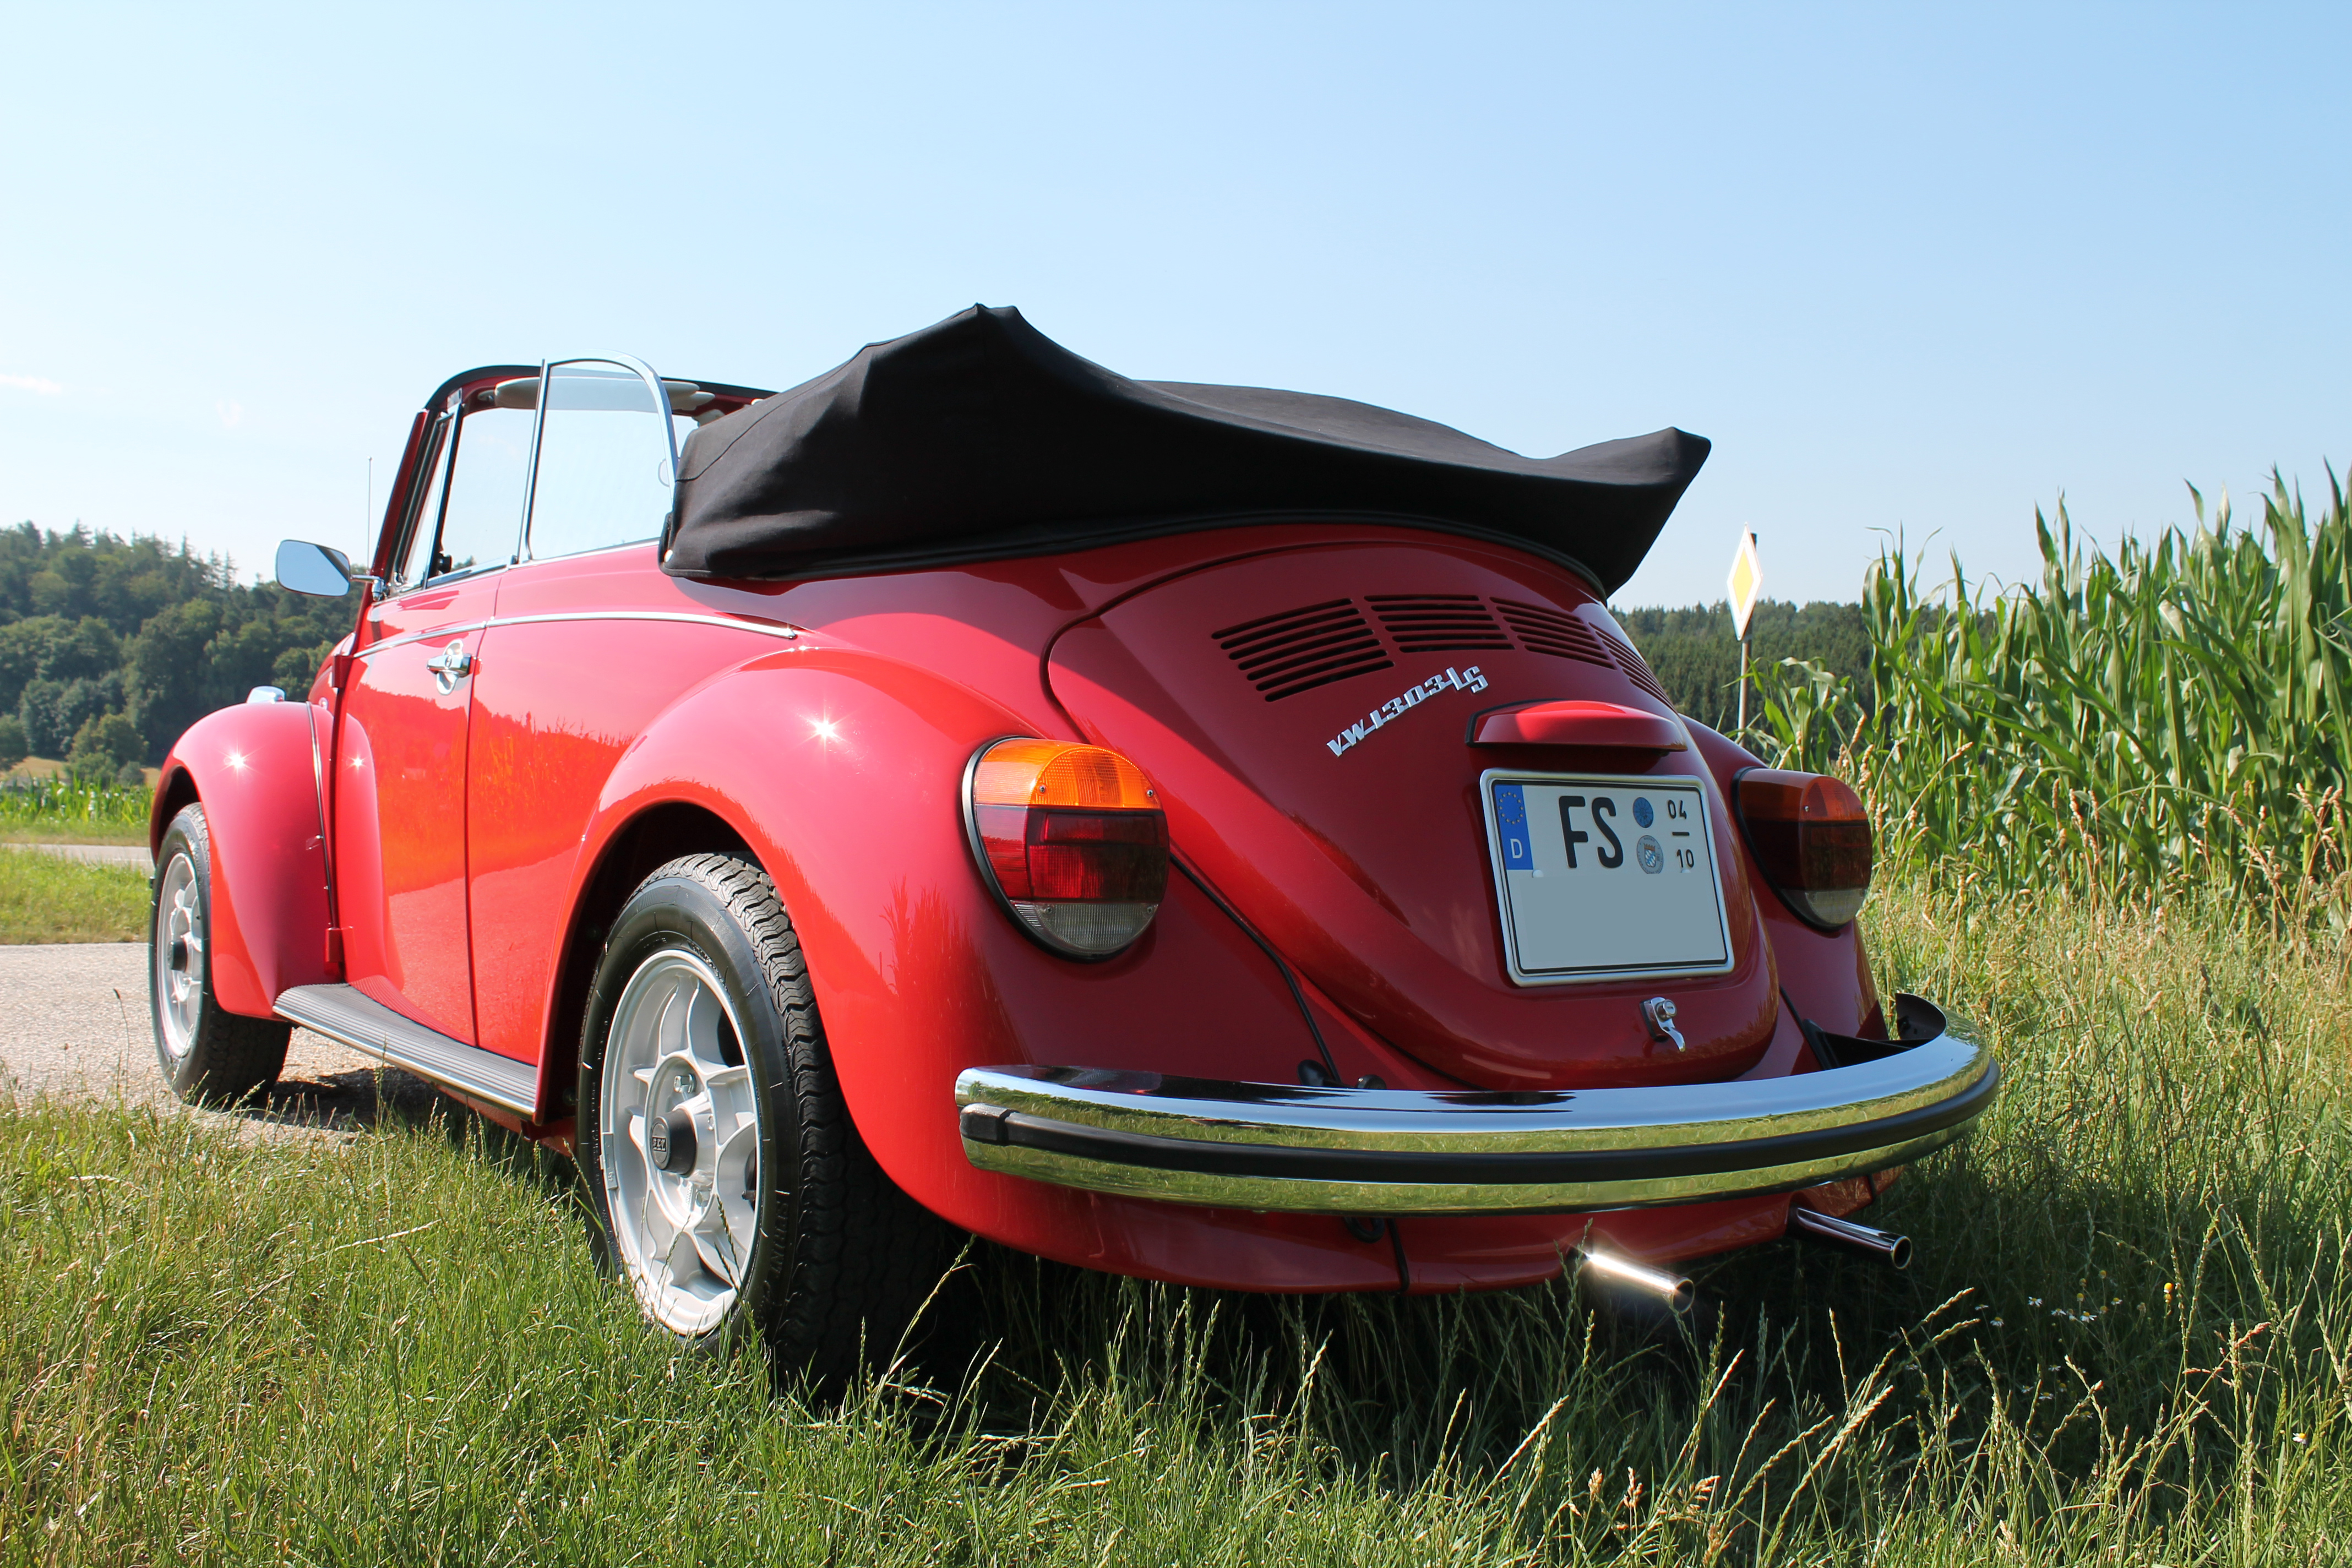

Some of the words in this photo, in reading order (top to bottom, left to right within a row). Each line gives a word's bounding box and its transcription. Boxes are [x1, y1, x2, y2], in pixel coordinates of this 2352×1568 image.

[1667, 799, 1687, 820] 04
[1558, 796, 1624, 868] FS
[1510, 838, 1523, 859] D
[1675, 848, 1695, 868] 10
